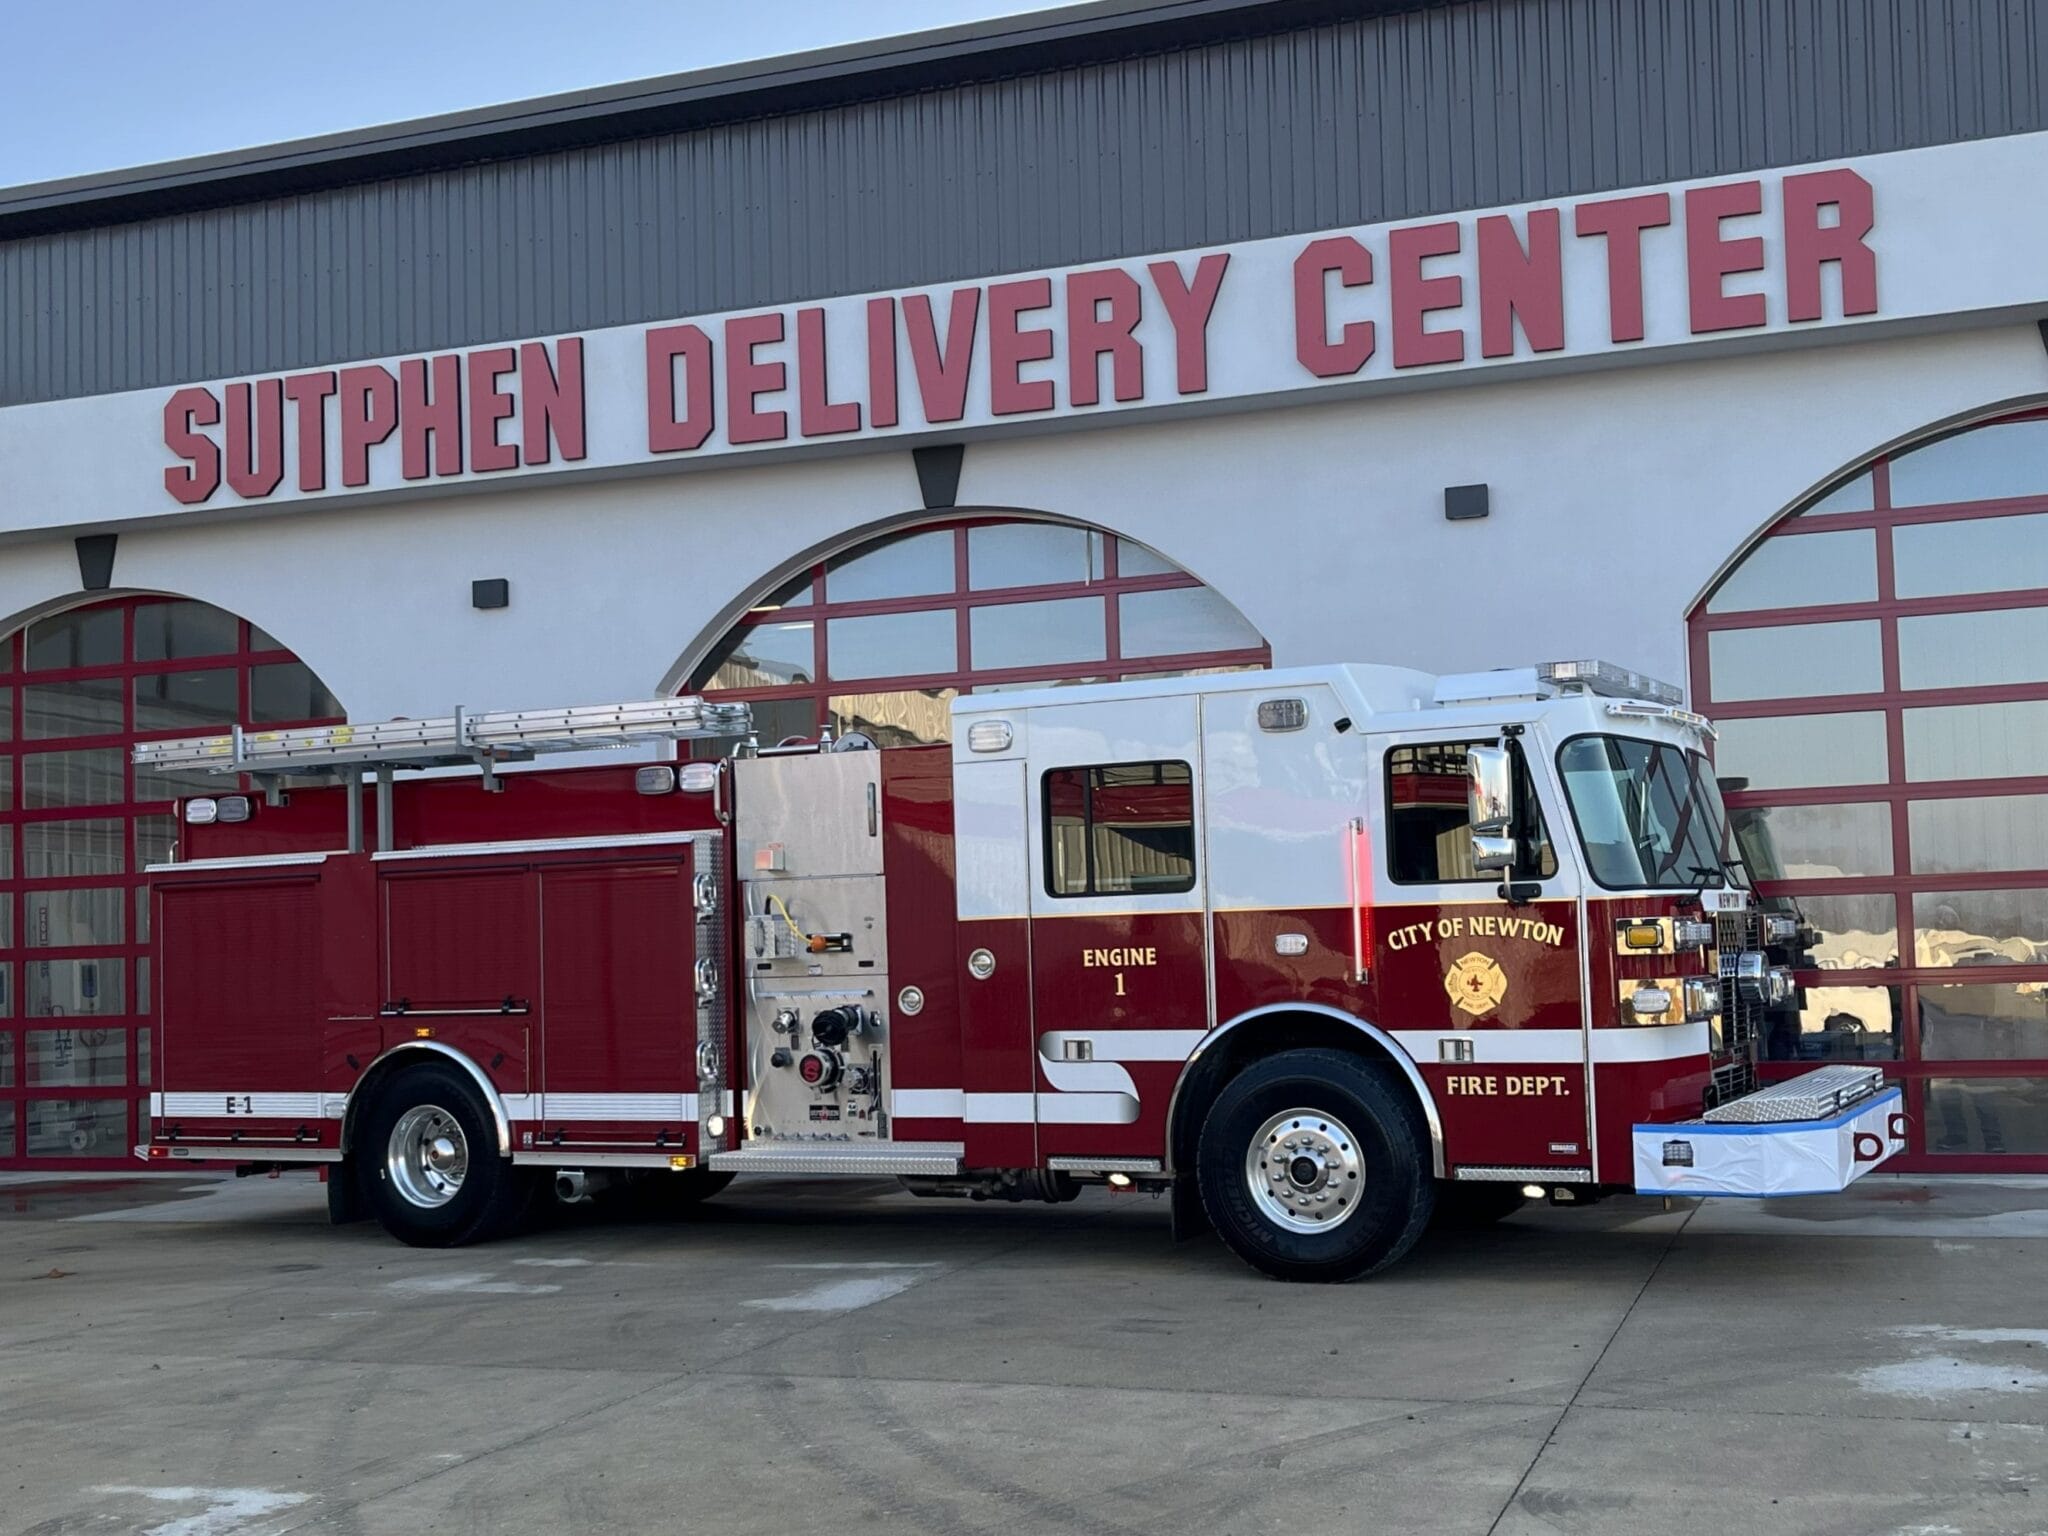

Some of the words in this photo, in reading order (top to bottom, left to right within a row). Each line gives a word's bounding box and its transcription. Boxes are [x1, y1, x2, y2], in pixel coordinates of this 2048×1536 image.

[164, 337, 586, 504] SUTPHEN
[646, 253, 1230, 453] DELIVERY
[1294, 168, 1878, 378] CENTER
[1388, 921, 1433, 950] CITY
[1438, 917, 1463, 938] OF
[1469, 916, 1564, 946] NEWTON
[1083, 947, 1157, 967] ENGINE
[1115, 973, 1126, 995] 1
[1447, 1076, 1498, 1095] FIRE
[1505, 1076, 1570, 1096] DEPT.
[226, 1096, 253, 1114] E-1
